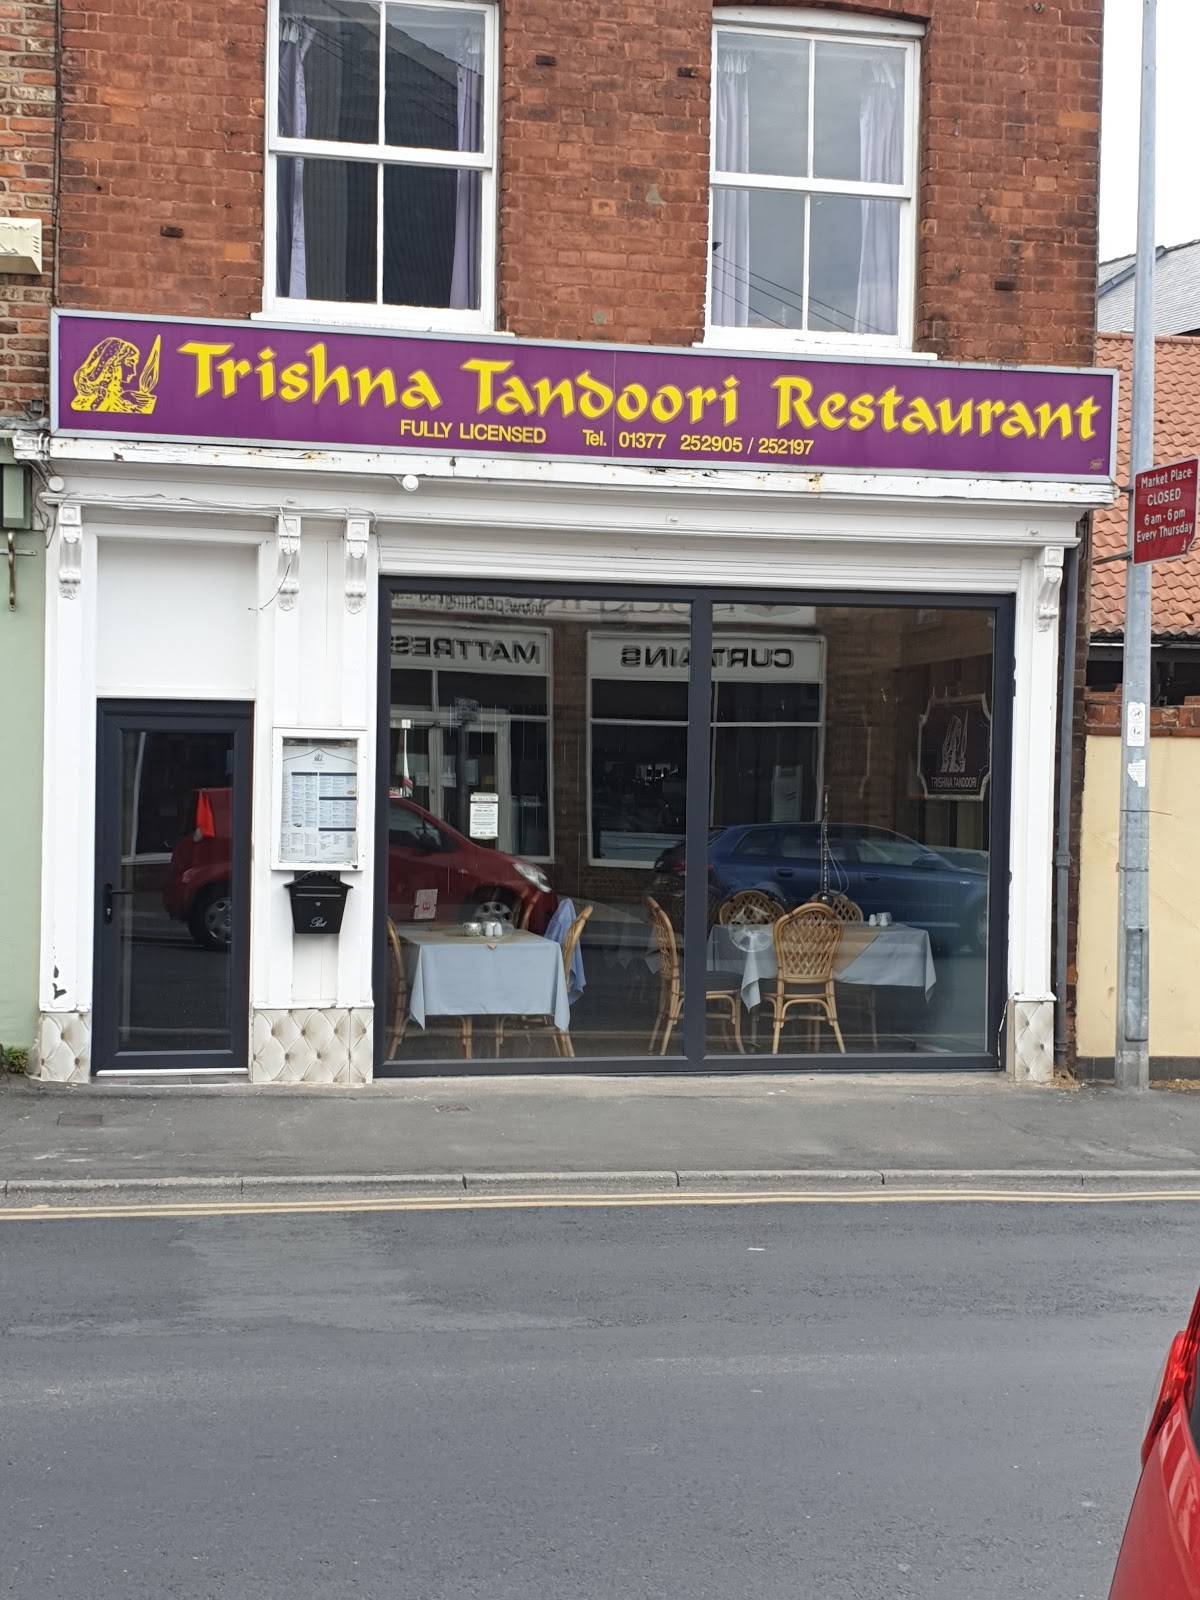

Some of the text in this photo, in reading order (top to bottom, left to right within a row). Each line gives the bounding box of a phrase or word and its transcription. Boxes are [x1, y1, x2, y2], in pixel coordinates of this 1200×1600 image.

[178, 340, 1103, 441] Trishna Tandoori Restaurant
[400, 419, 547, 444] FULLY LICENSED
[582, 429, 607, 447] Tel.
[618, 431, 667, 449] 01377
[680, 434, 743, 453] 252905
[758, 437, 814, 455] 252197
[1141, 468, 1193, 489] Market Place
[1147, 487, 1181, 506] CLOSED
[1136, 521, 1193, 543] Every Thursday
